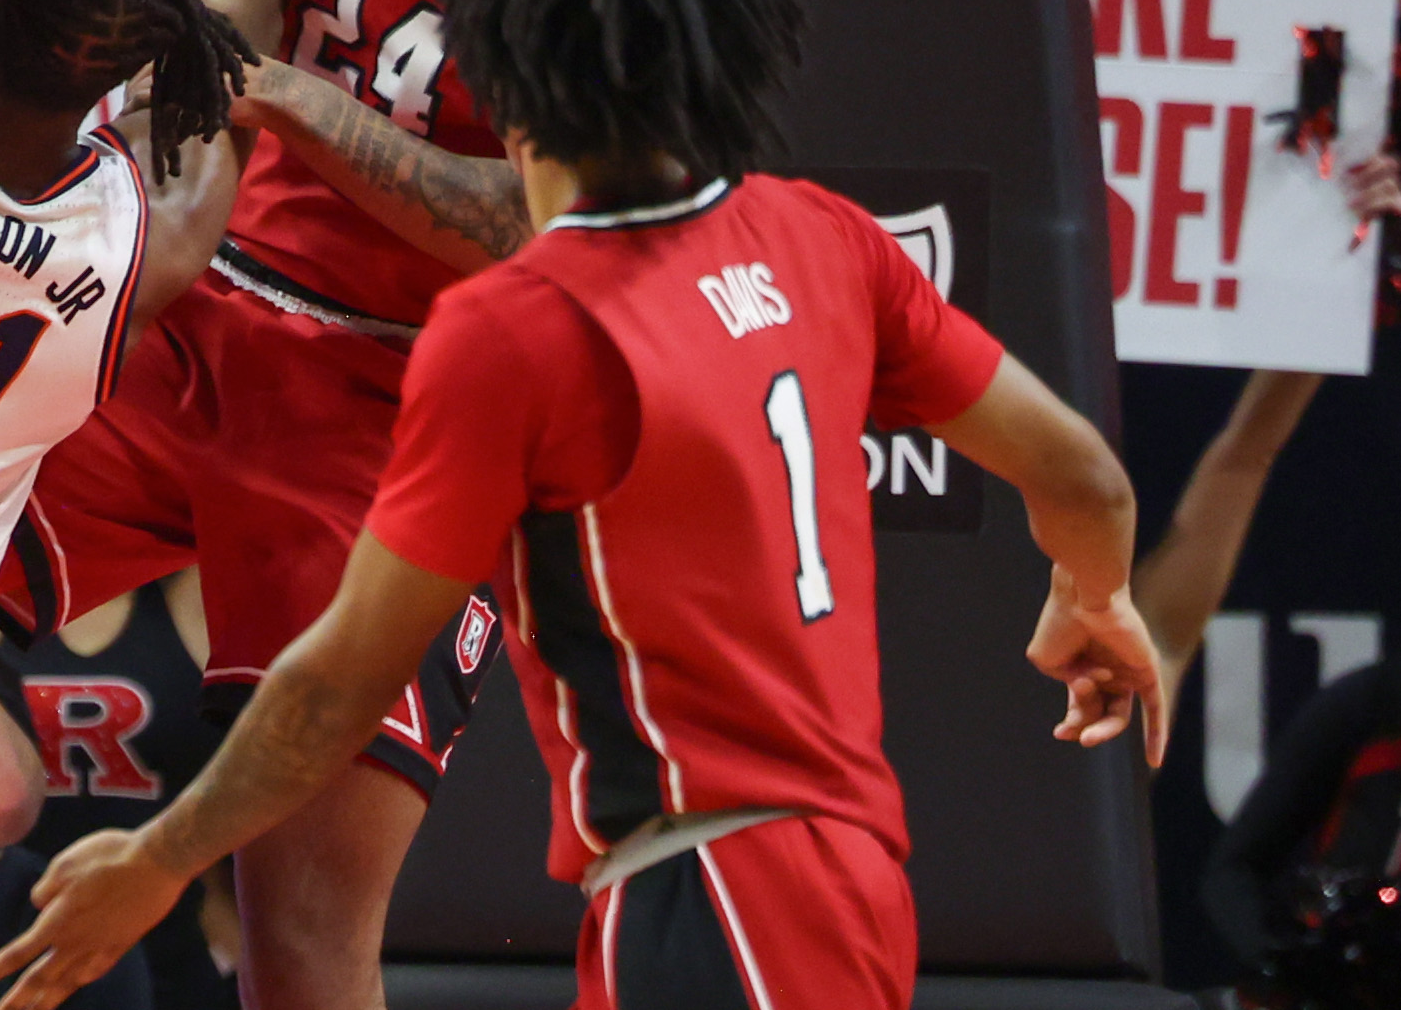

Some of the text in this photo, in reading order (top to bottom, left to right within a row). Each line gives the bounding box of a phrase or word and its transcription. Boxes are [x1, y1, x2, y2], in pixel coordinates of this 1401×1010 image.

[45, 265, 106, 326] JR
[762, 368, 835, 626] 1
[20, 674, 165, 801] R
